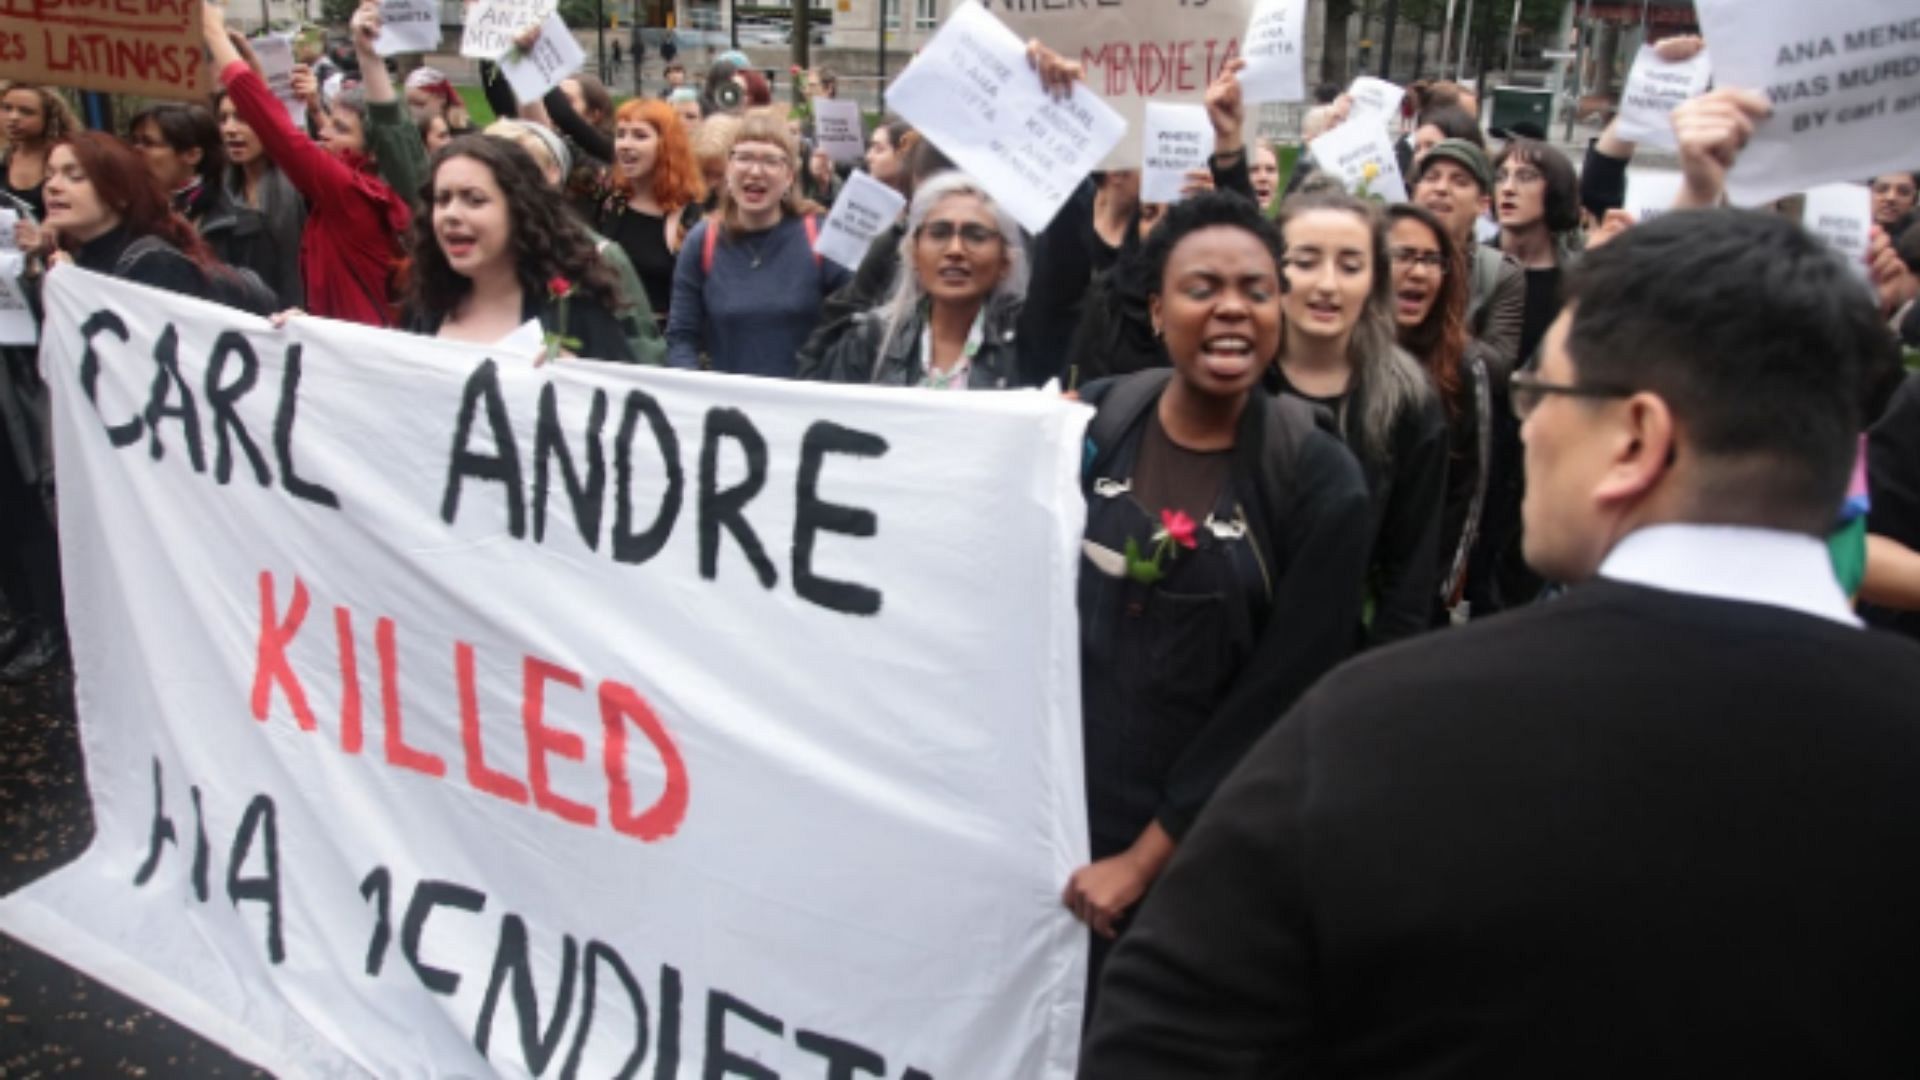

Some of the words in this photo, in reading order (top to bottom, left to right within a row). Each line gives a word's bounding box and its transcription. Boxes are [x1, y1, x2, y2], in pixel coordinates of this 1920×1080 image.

[44, 28, 202, 90] LATINAS?
[1775, 36, 1837, 67] ANA
[1765, 75, 1831, 104] WAS
[1790, 109, 1831, 133] BY
[80, 308, 342, 510] CARL
[440, 358, 889, 618] ANDRE
[250, 570, 691, 843] KILLED
